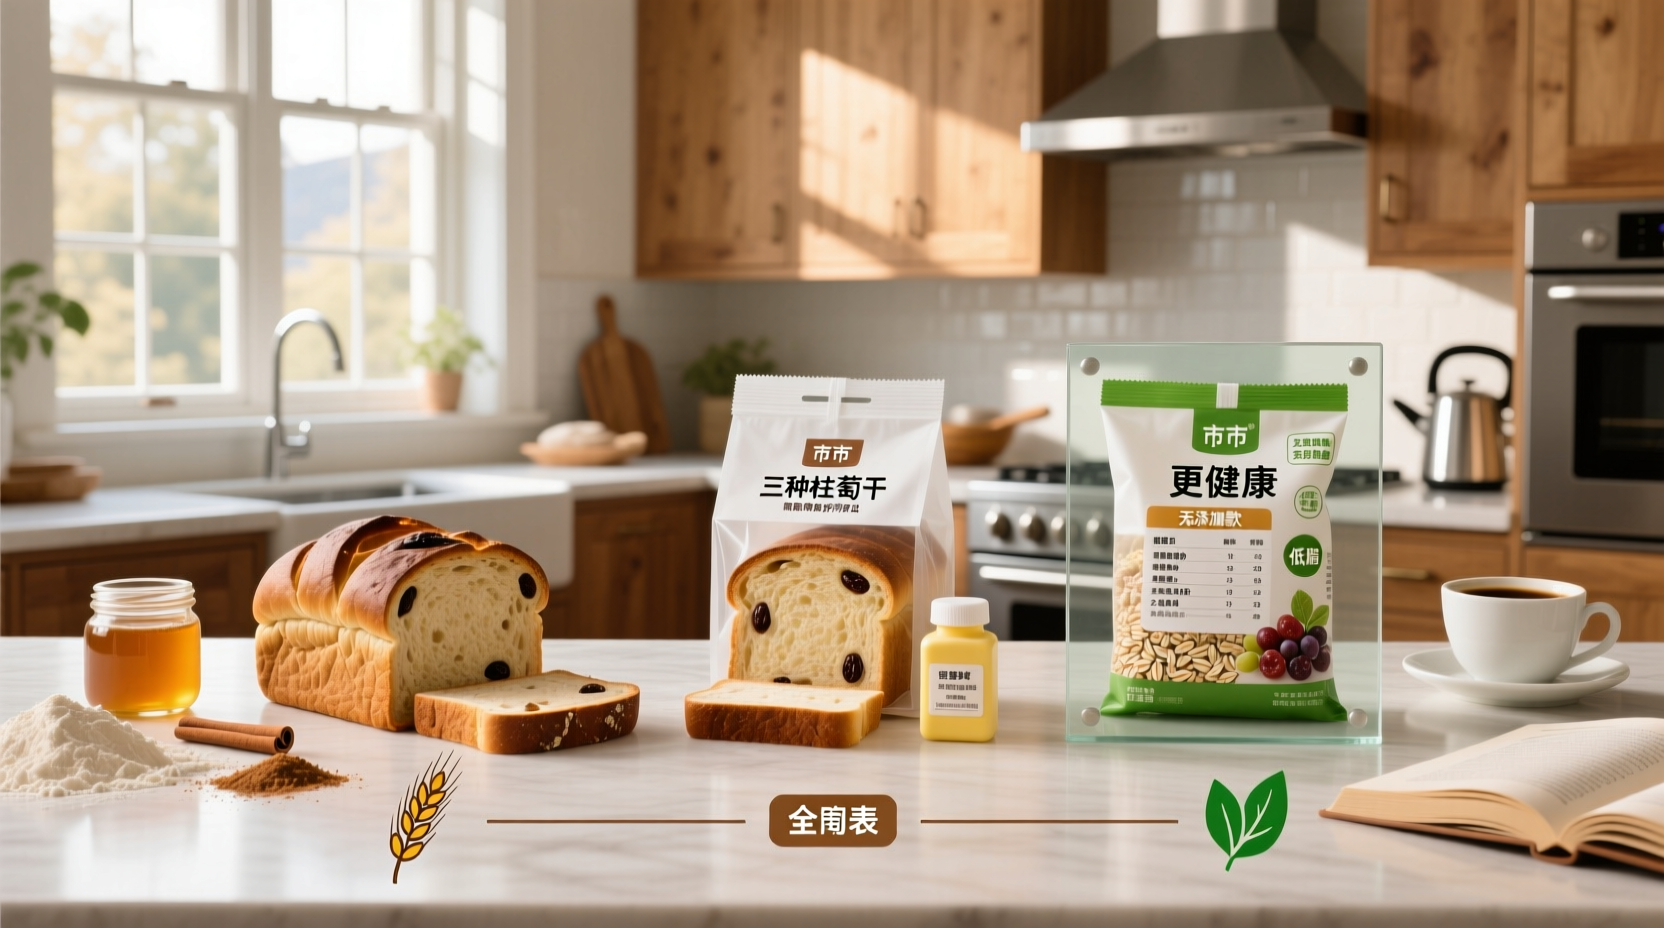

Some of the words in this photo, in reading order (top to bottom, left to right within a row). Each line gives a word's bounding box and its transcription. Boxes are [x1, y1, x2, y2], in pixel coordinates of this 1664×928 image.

[1202, 424, 1248, 448] 市市
[813, 444, 853, 463] 市市
[1169, 464, 1278, 499] 更健康
